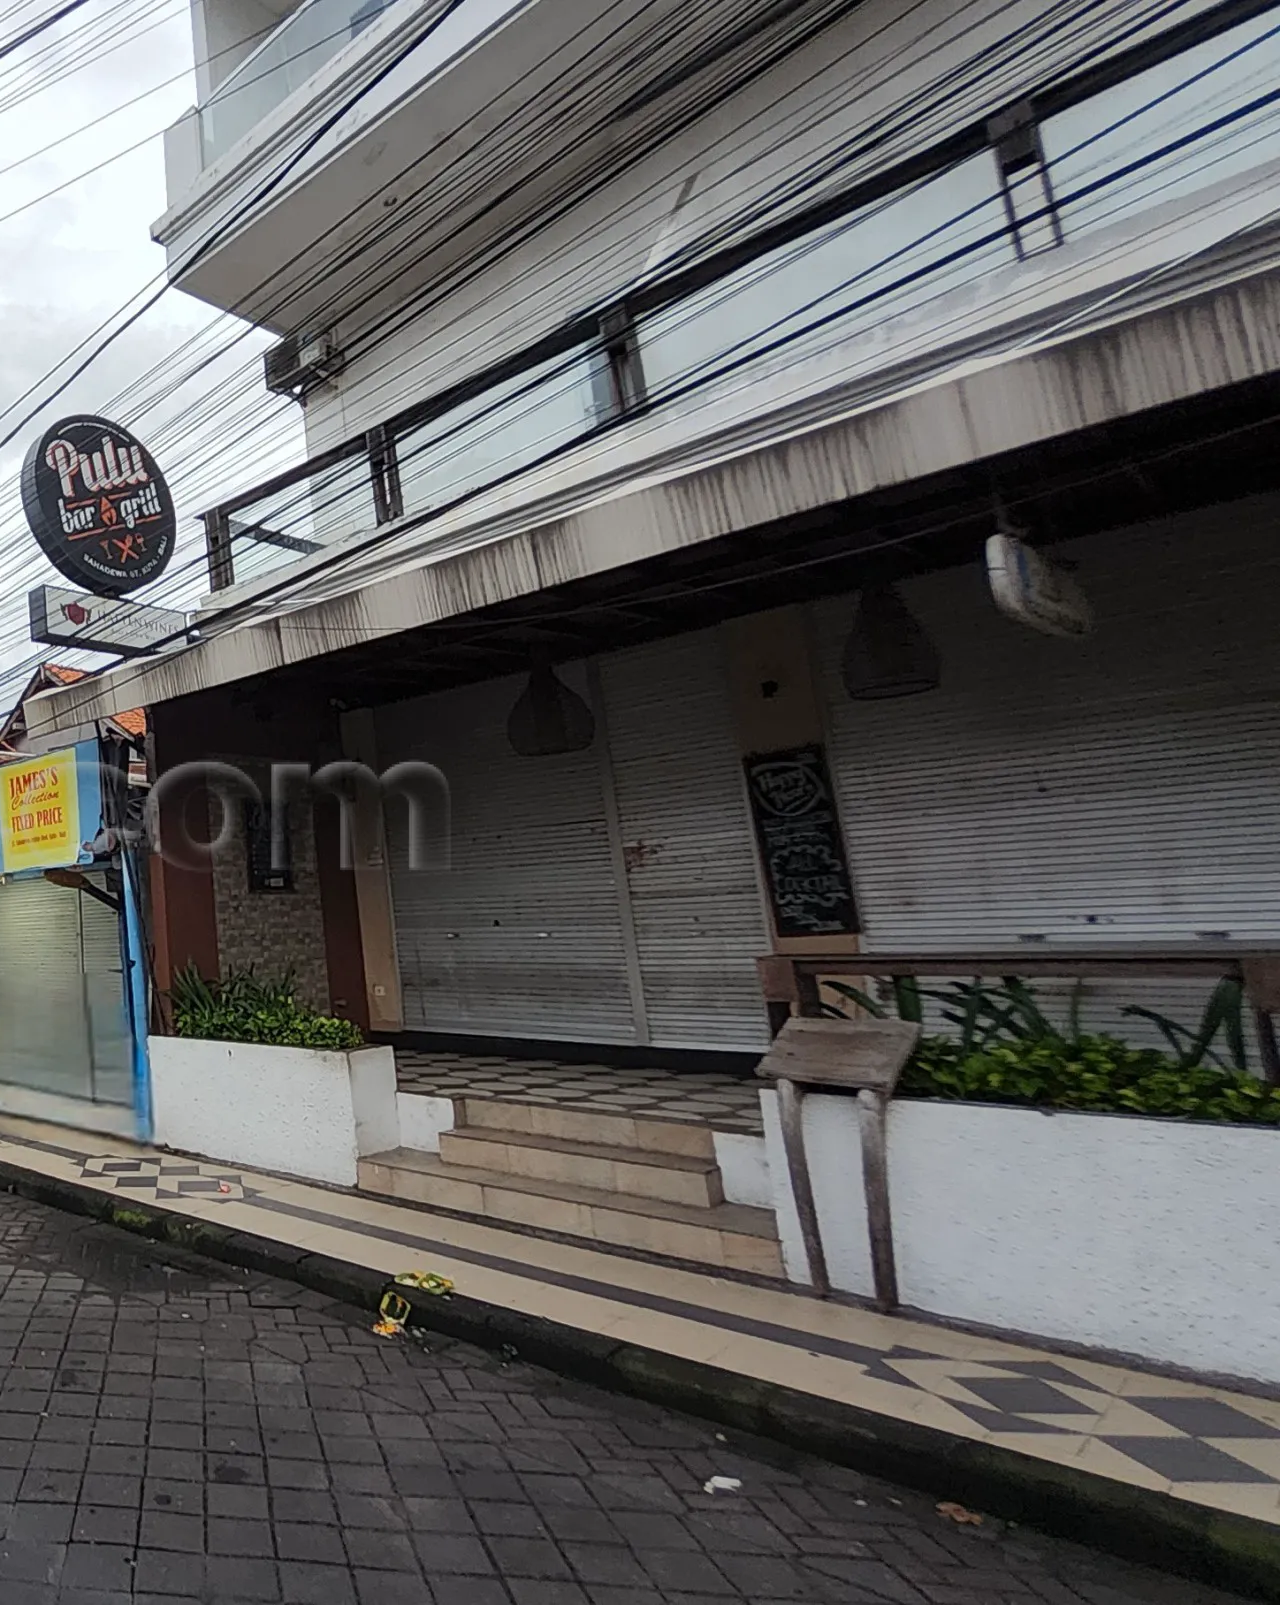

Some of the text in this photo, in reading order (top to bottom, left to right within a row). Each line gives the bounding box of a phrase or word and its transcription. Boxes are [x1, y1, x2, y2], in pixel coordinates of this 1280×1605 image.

[58, 482, 161, 533] bar grill
[10, 766, 58, 800] JAMES'S
[11, 791, 59, 811] Collection
[36, 806, 63, 828] PRICE
